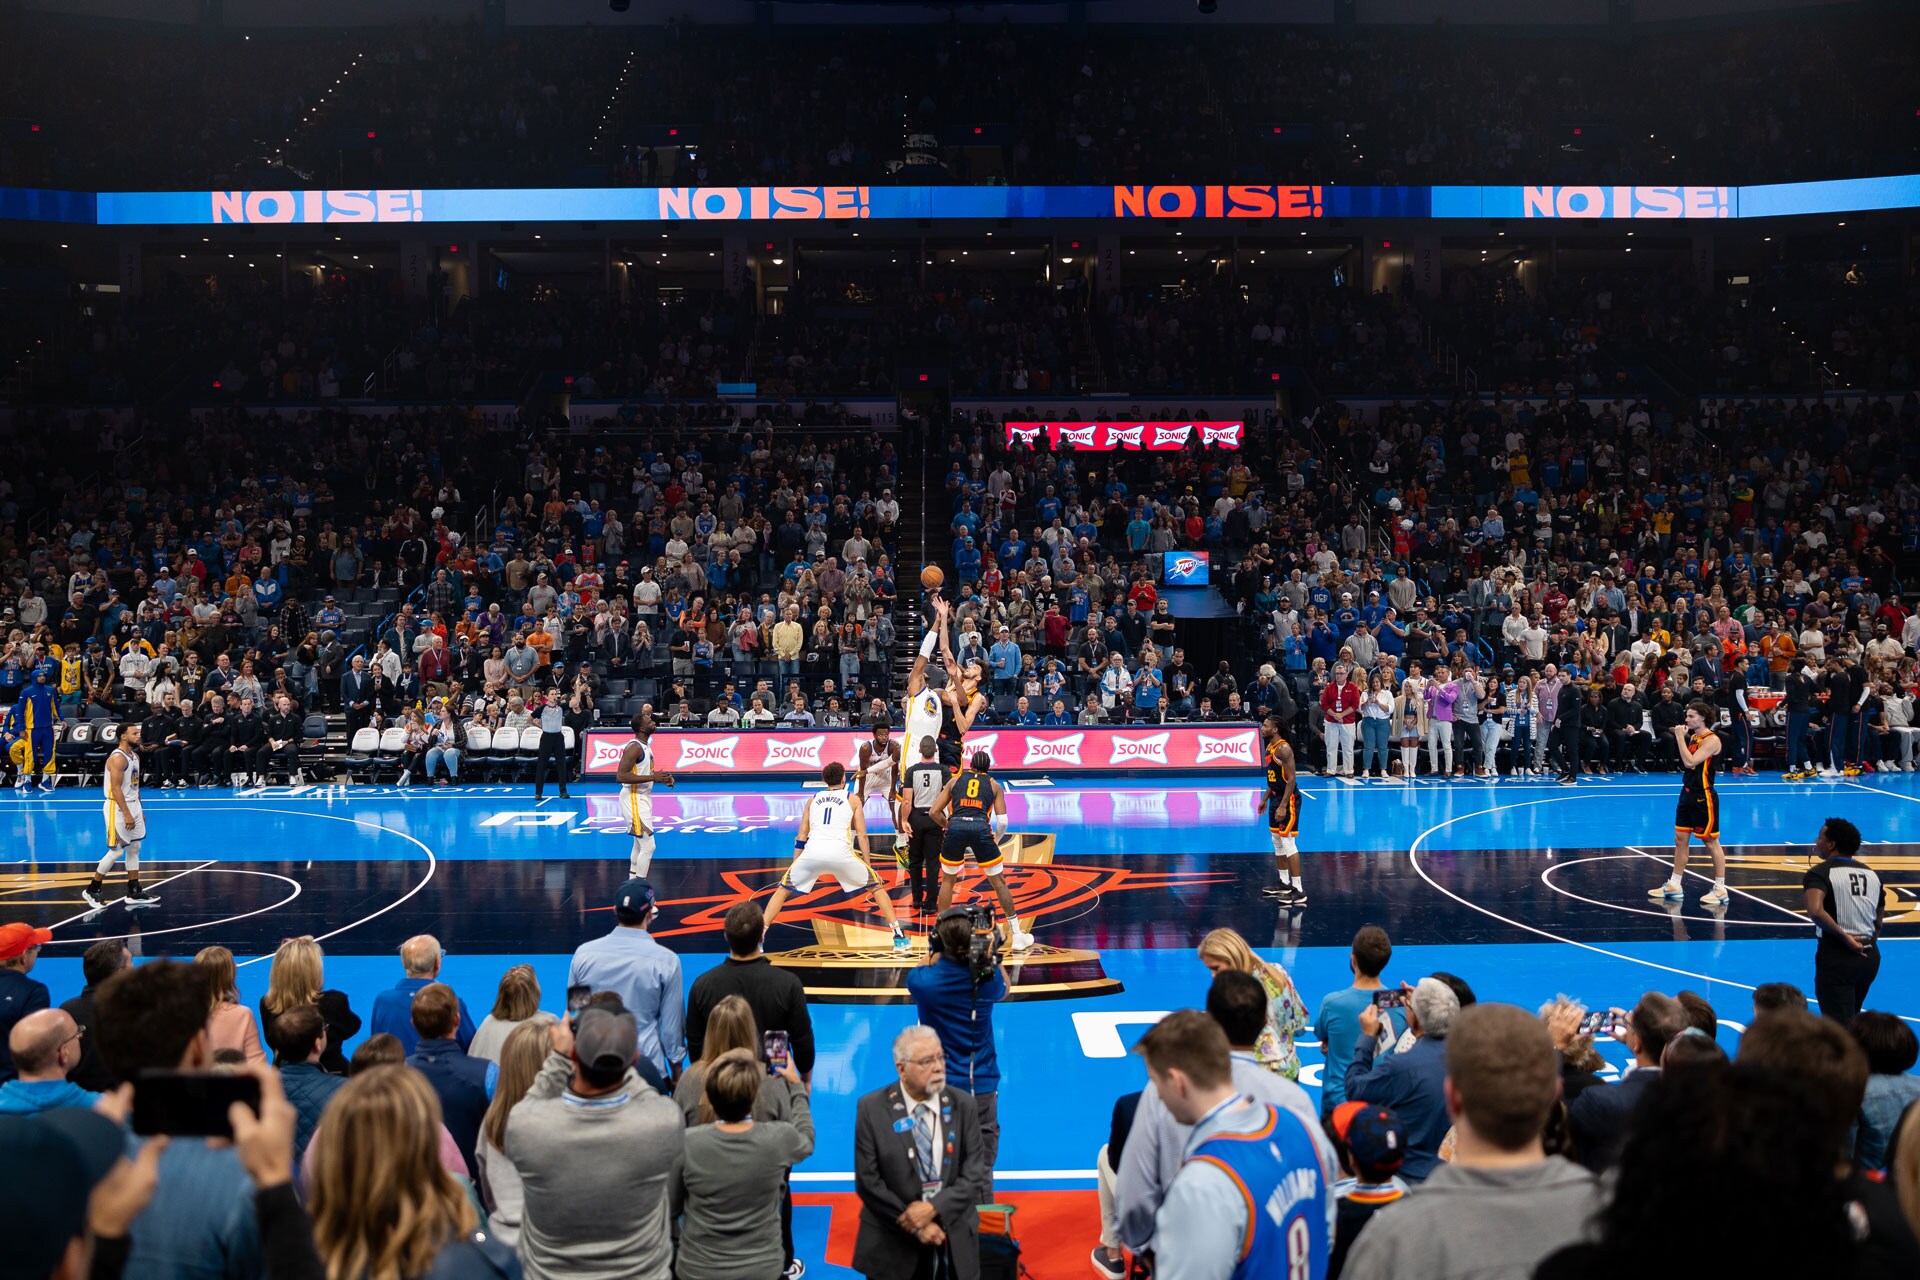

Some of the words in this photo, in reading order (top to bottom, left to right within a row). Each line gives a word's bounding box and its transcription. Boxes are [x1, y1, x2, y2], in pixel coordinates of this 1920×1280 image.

[211, 190, 423, 224] NOISE!
[658, 186, 870, 220] NOISE!
[1113, 185, 1323, 218] NOISE!
[1523, 186, 1728, 218] NOISE!
[572, 414, 591, 425] 115
[874, 411, 894, 424] 115
[1110, 432, 1139, 441] SONIC
[1158, 431, 1187, 440] SONIC
[1206, 431, 1234, 440] SONIC
[684, 747, 730, 759] SONIC
[771, 746, 816, 759] SONIC
[1031, 744, 1076, 756] SONIC
[1117, 743, 1162, 755] SONIC
[1203, 742, 1248, 754] SONIC
[923, 773, 931, 788] 3
[966, 778, 980, 798] 8
[815, 796, 844, 806] THOMPSON
[959, 798, 983, 809] WILLIAMS
[579, 816, 803, 825] pyco
[823, 807, 832, 825] 11
[1849, 873, 1867, 896] 27
